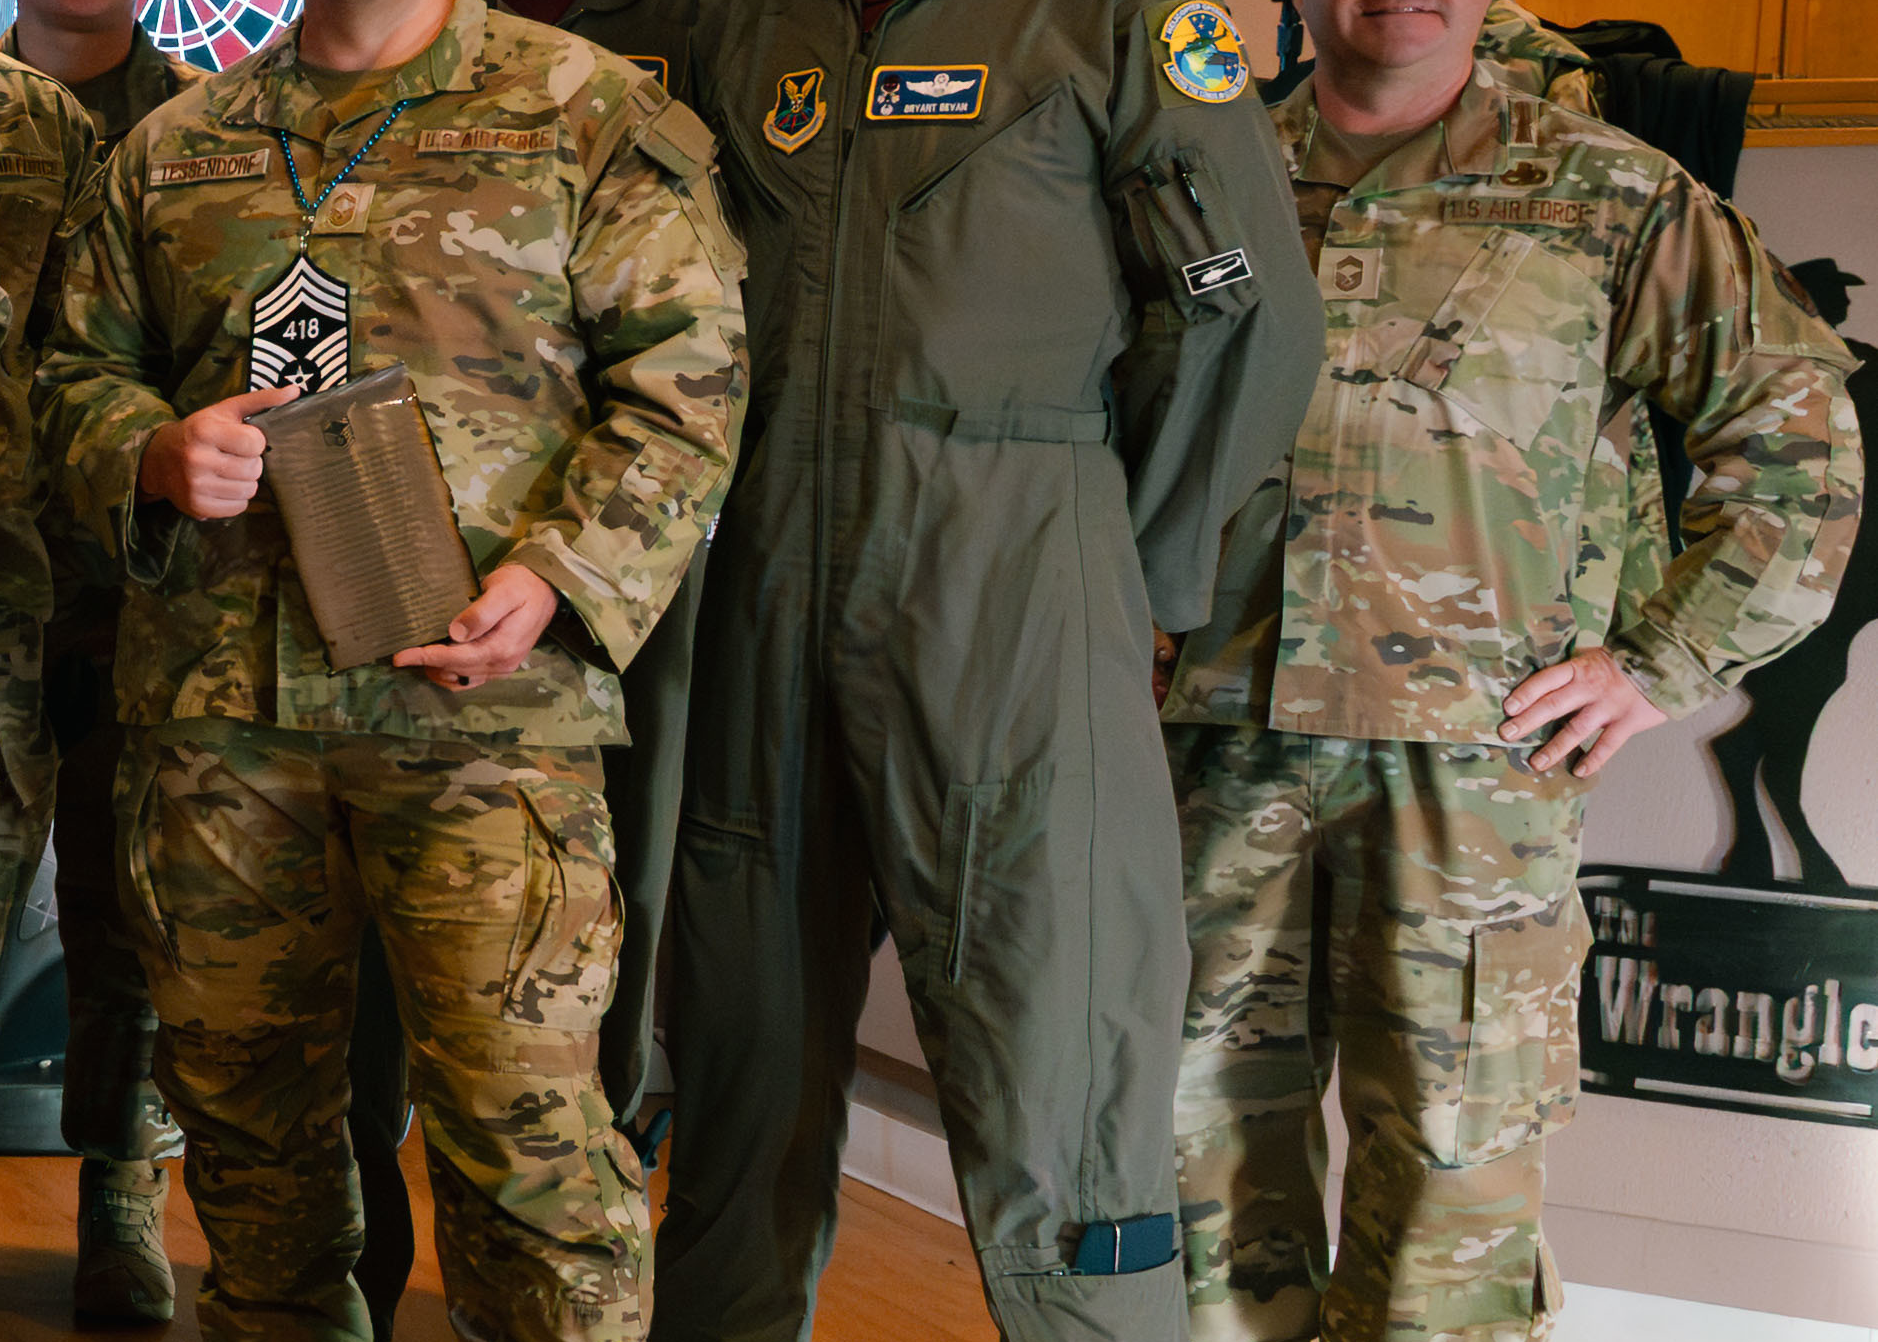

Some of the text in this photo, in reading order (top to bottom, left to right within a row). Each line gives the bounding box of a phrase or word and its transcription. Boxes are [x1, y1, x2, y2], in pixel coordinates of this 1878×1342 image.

[161, 152, 259, 181] TESSENDORF
[1488, 199, 1522, 220] AIR
[1527, 199, 1590, 223] FORCE
[282, 317, 320, 341] 418
